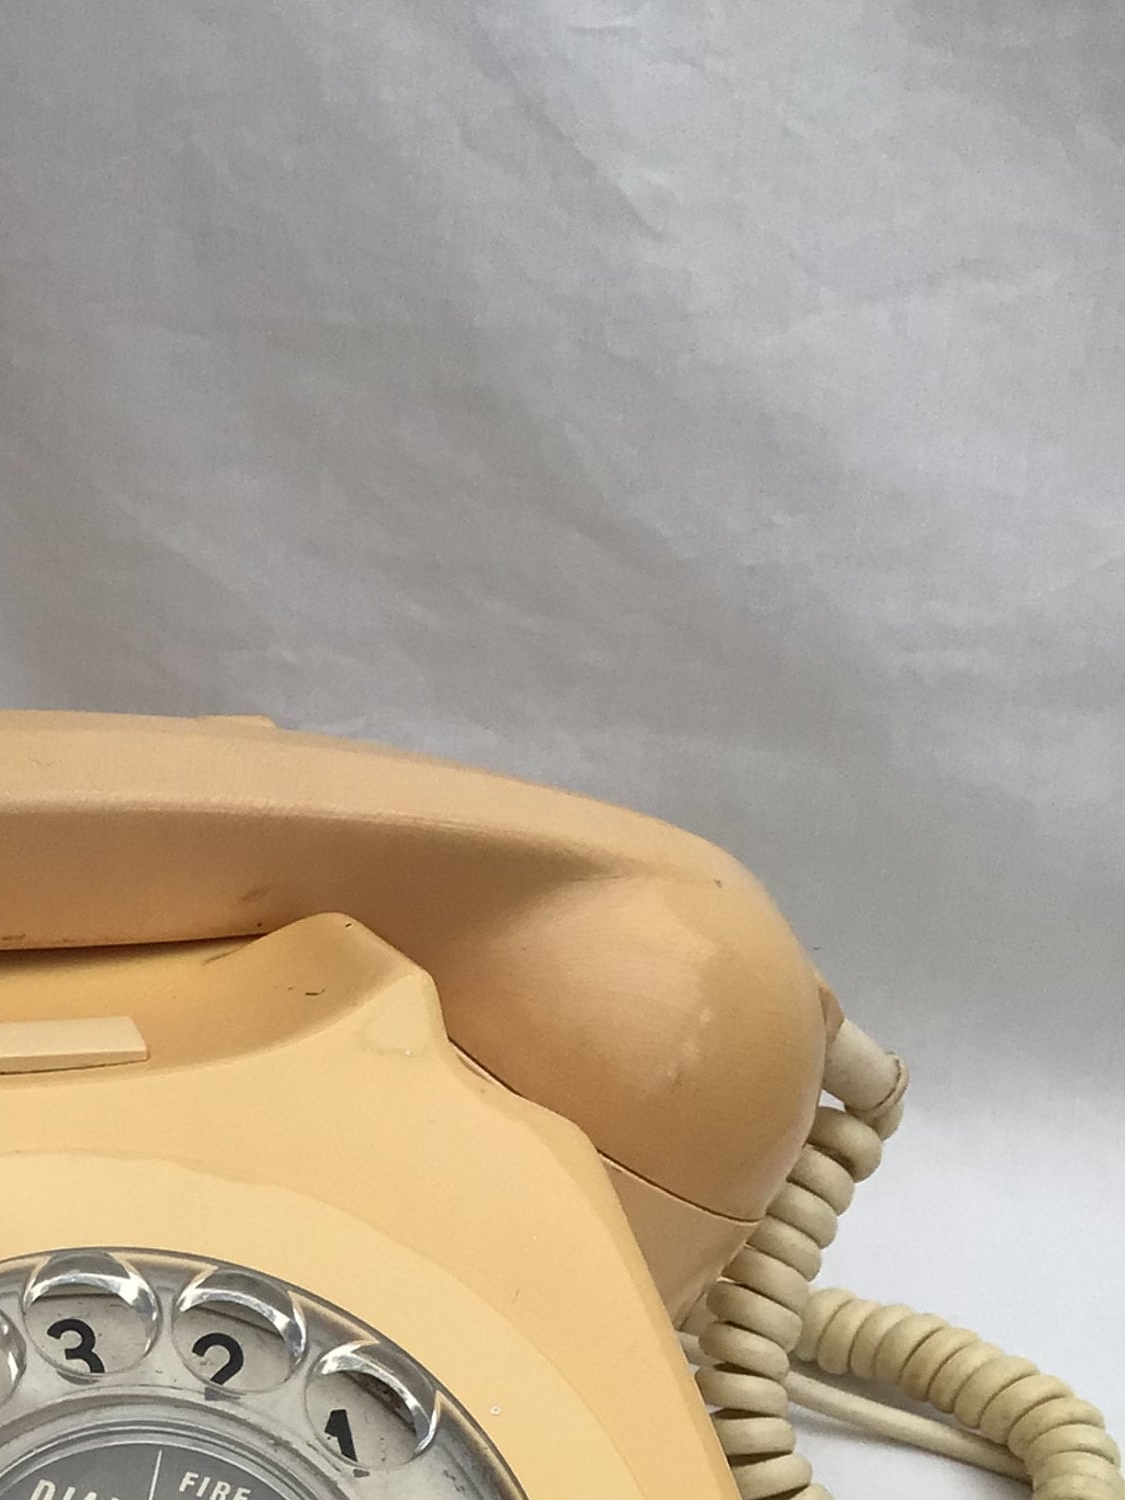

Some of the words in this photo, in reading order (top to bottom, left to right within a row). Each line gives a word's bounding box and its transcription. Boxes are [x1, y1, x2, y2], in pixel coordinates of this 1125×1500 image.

[45, 1318, 106, 1379] 3
[191, 1333, 245, 1402] 2
[324, 1408, 366, 1471] 1
